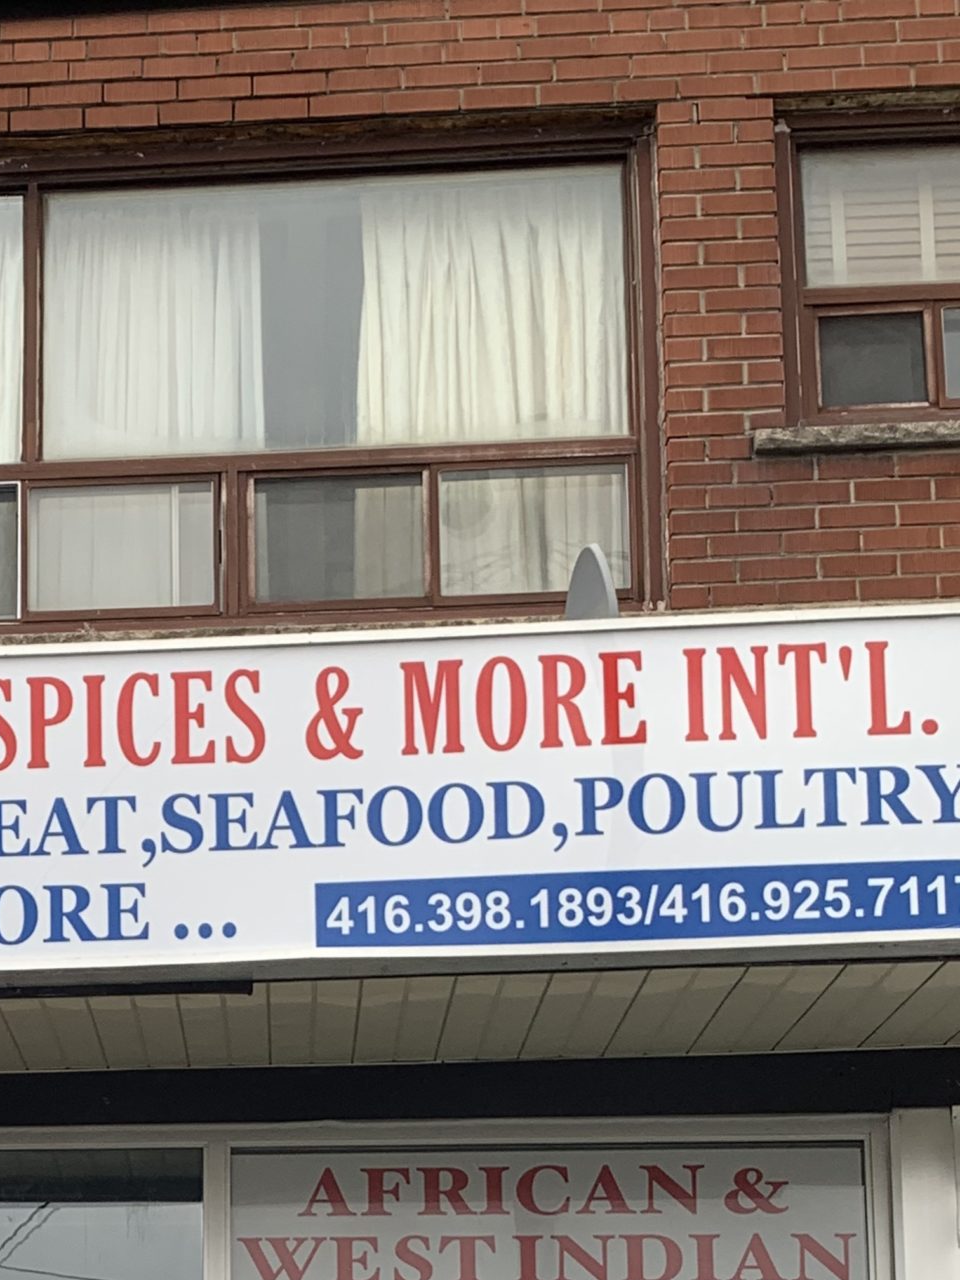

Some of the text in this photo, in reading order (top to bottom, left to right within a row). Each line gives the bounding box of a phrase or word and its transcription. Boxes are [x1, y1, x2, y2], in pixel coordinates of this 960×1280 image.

[305, 666, 363, 760] &
[400, 651, 647, 755] MORE
[682, 641, 939, 741] INT'L.
[297, 1165, 789, 1217] AFRICAN &
